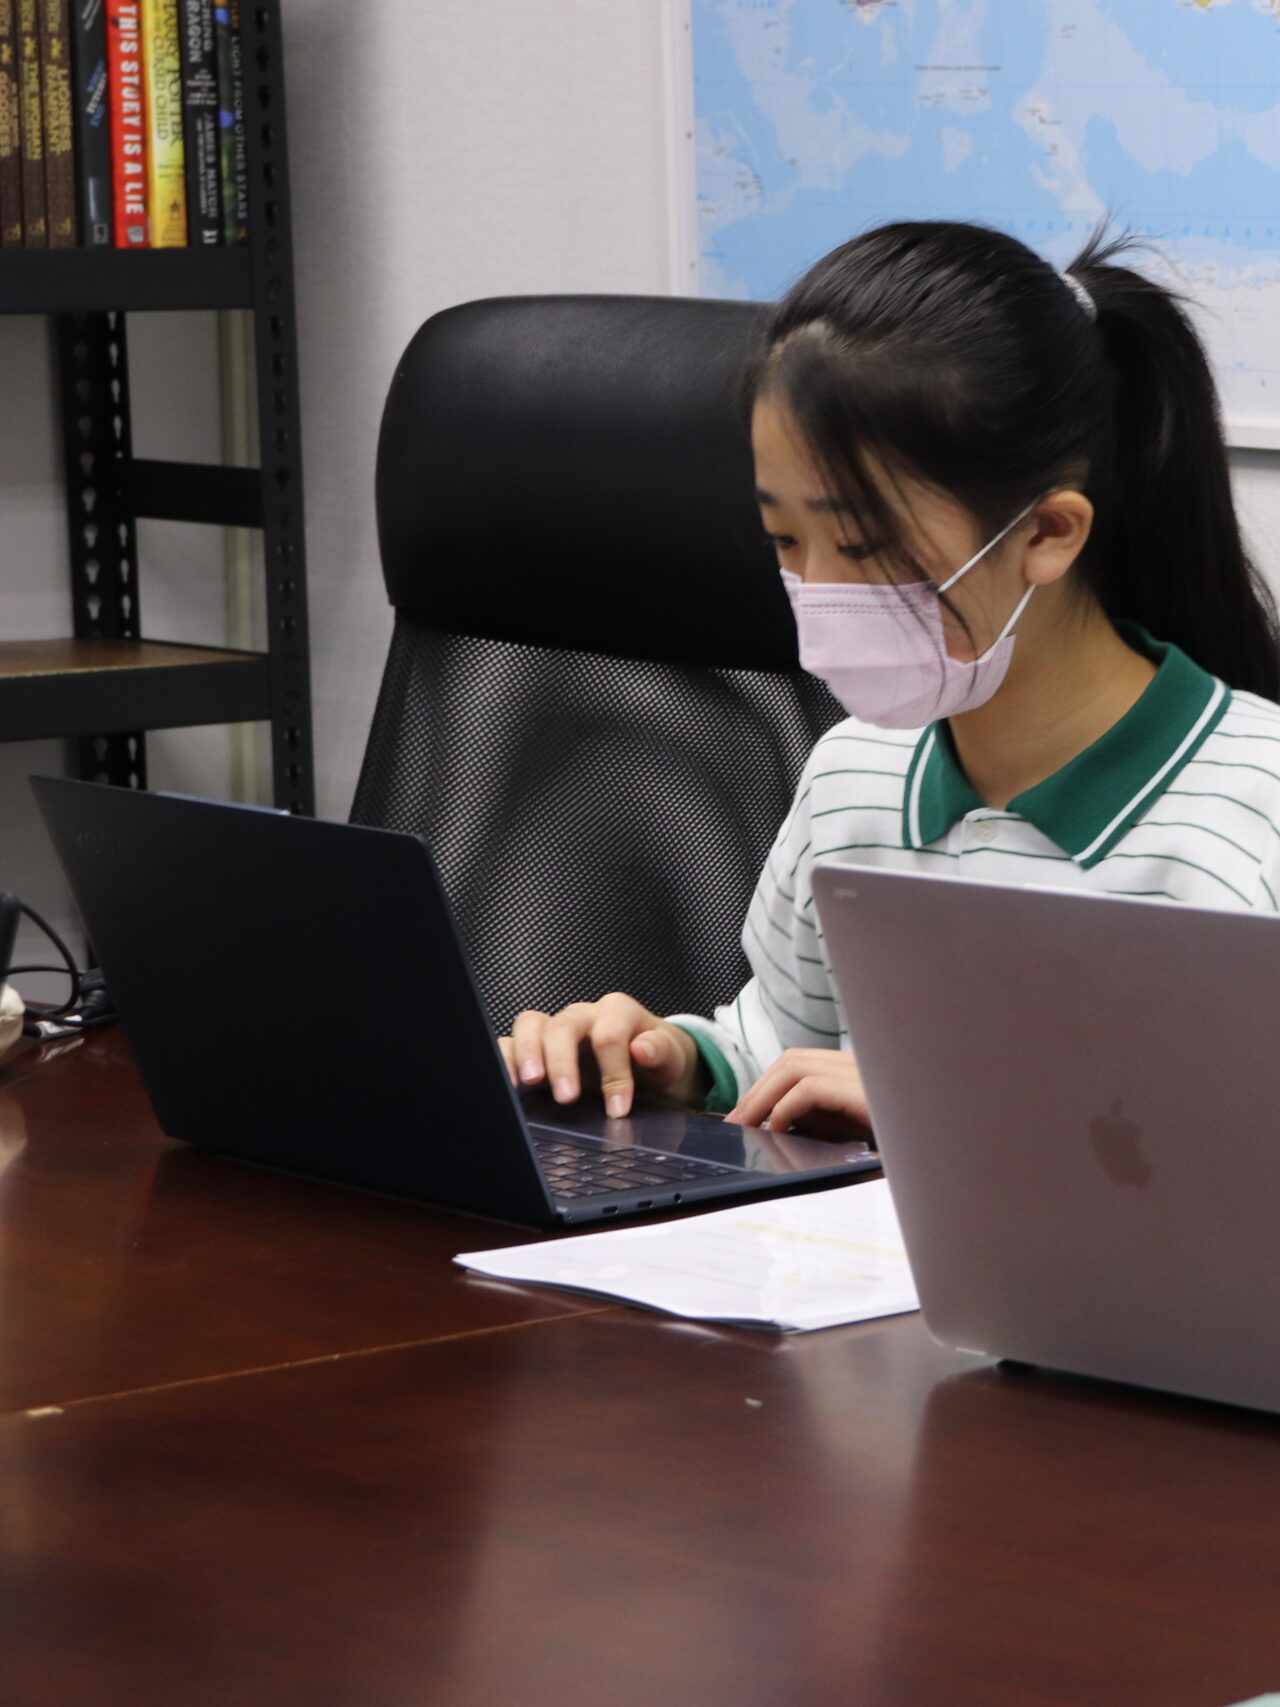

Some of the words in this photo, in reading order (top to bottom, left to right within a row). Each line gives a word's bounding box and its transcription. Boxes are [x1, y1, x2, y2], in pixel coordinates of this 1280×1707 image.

[118, 5, 139, 53] THIS
[152, 35, 166, 90] CURSED
[231, 36, 243, 76] LIGHT
[45, 64, 60, 154] RAMPANT
[57, 68, 72, 152] LIONESS
[120, 60, 141, 127] STORY
[233, 80, 245, 120] FROM
[30, 97, 42, 160] WOMAN
[155, 95, 168, 140] CHILD
[203, 112, 216, 164] JAMES
[123, 134, 142, 155] IS
[234, 123, 246, 170] OTHER
[124, 162, 143, 175] A
[125, 182, 144, 215] LIE
[206, 168, 218, 218] HATCH
[236, 174, 248, 219] STARS
